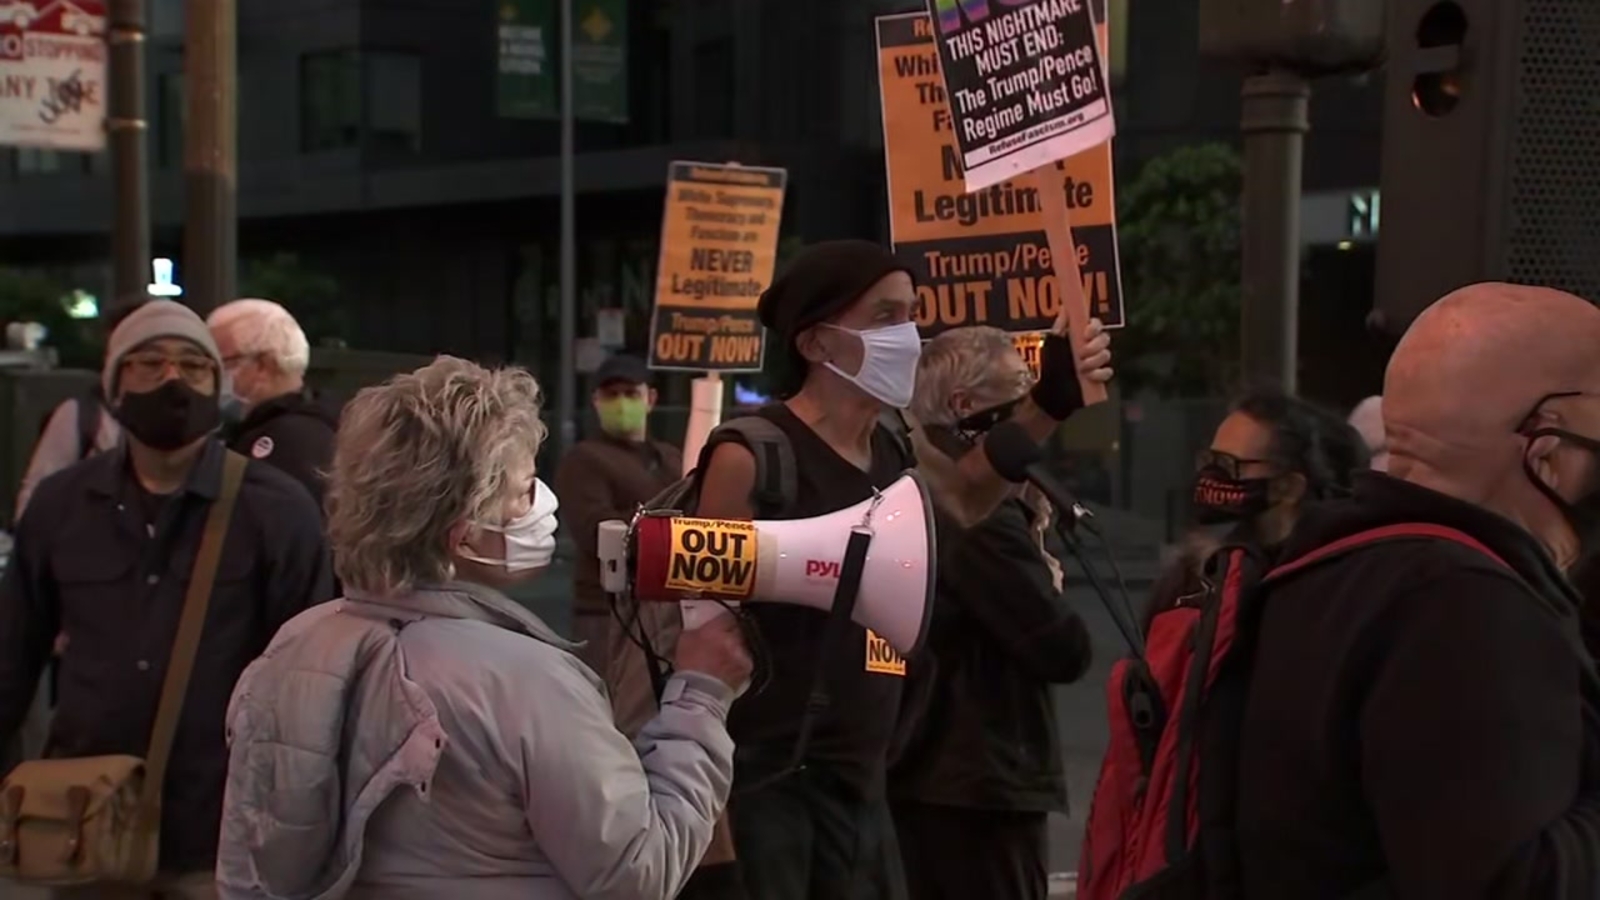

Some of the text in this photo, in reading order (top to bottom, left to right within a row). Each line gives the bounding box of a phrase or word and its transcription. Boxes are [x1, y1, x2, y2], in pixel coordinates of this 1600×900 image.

[946, 27, 984, 61] THIS
[985, 0, 1081, 46] NIGHTMARE
[894, 52, 938, 78] Whi
[975, 25, 1064, 76] MUST END:
[955, 87, 986, 114] The
[987, 45, 1093, 97] Trump/Pence
[963, 103, 1023, 142] Regime
[1026, 81, 1068, 117] Must
[1071, 68, 1098, 98] Go!
[988, 112, 1085, 155] RefuseFascism.org
[914, 176, 1093, 226] Legitimte
[691, 248, 753, 272] NEVER
[925, 244, 1089, 280] Trump/Pee
[671, 273, 762, 300] Legitimate
[915, 281, 992, 327] OUT
[657, 333, 760, 362] OUT NOW!
[681, 529, 747, 558] OUT
[671, 553, 752, 587] NOW
[806, 560, 840, 578] PYL
